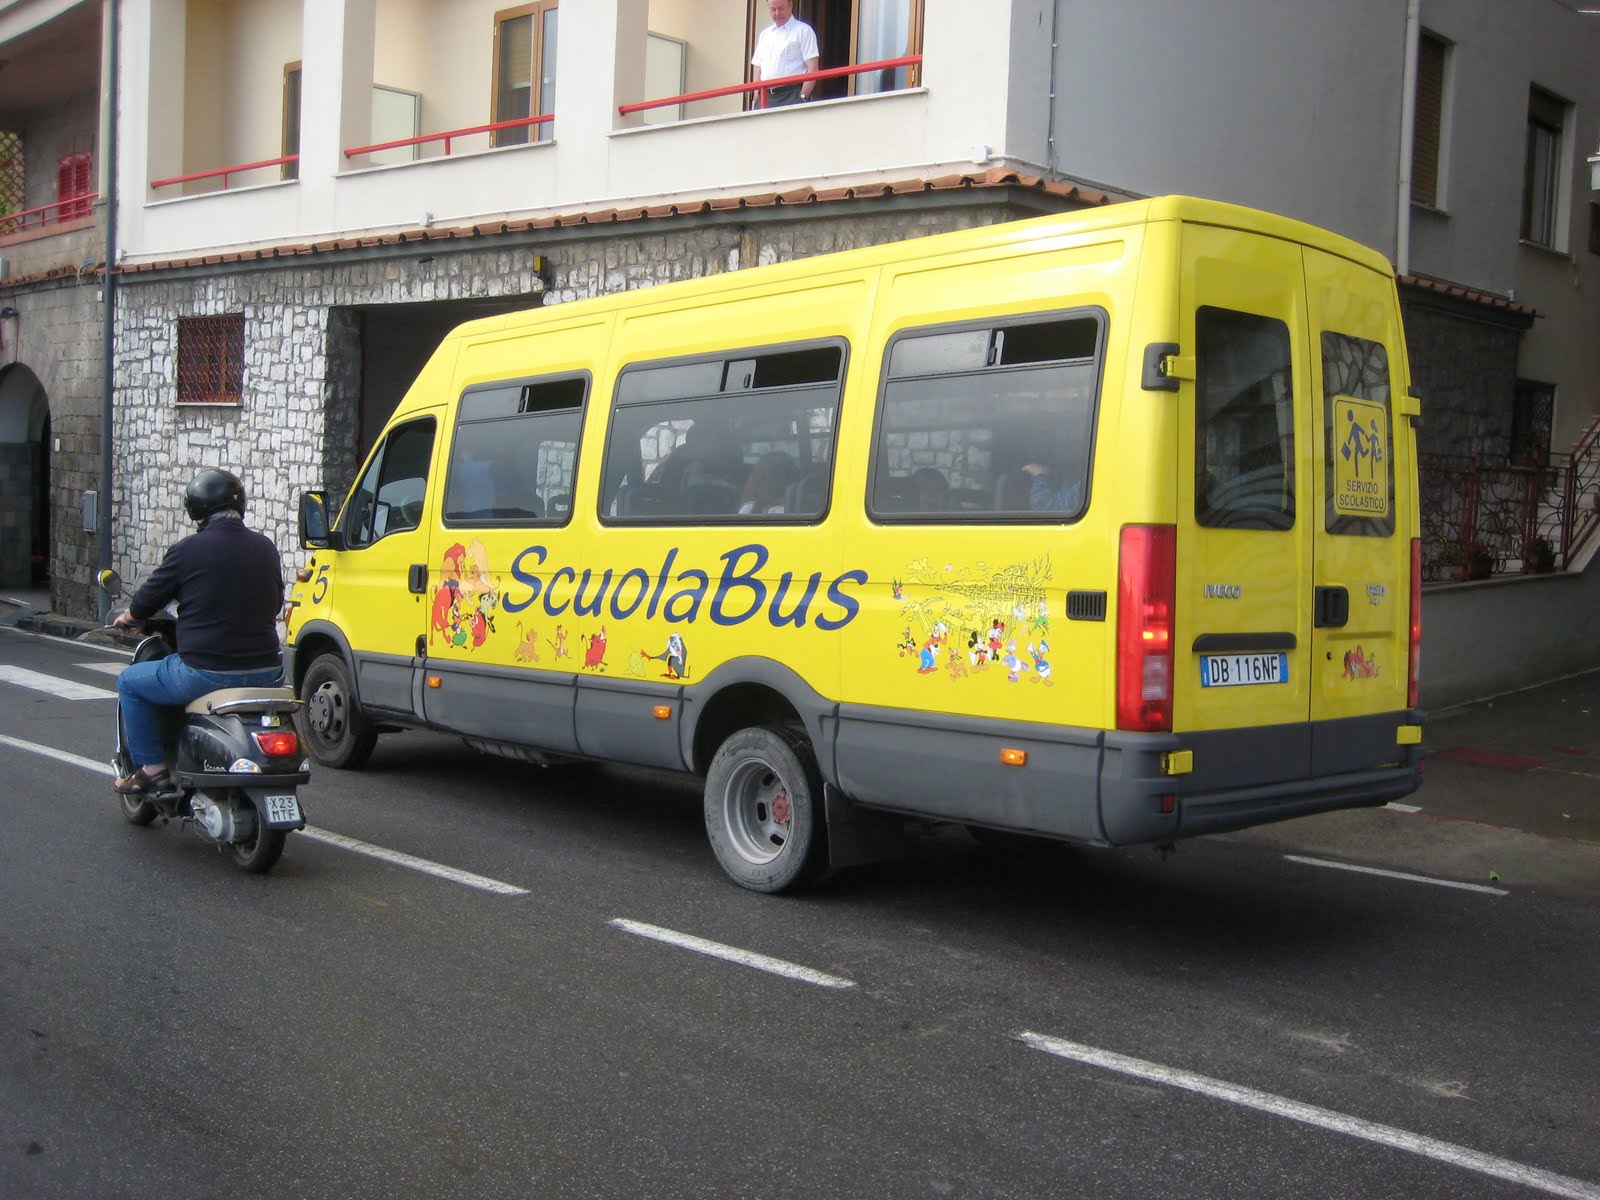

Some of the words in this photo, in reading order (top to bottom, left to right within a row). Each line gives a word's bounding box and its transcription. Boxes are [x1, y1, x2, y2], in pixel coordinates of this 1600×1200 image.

[1346, 480, 1378, 494] SERVIZIO
[1339, 494, 1384, 510] SCOLASTICO
[312, 564, 331, 605] 5
[502, 543, 868, 631] ScuolaBus
[1210, 658, 1230, 684] DB
[1235, 655, 1278, 682] 116NF
[271, 797, 294, 809] X23
[273, 809, 295, 821] MTF
